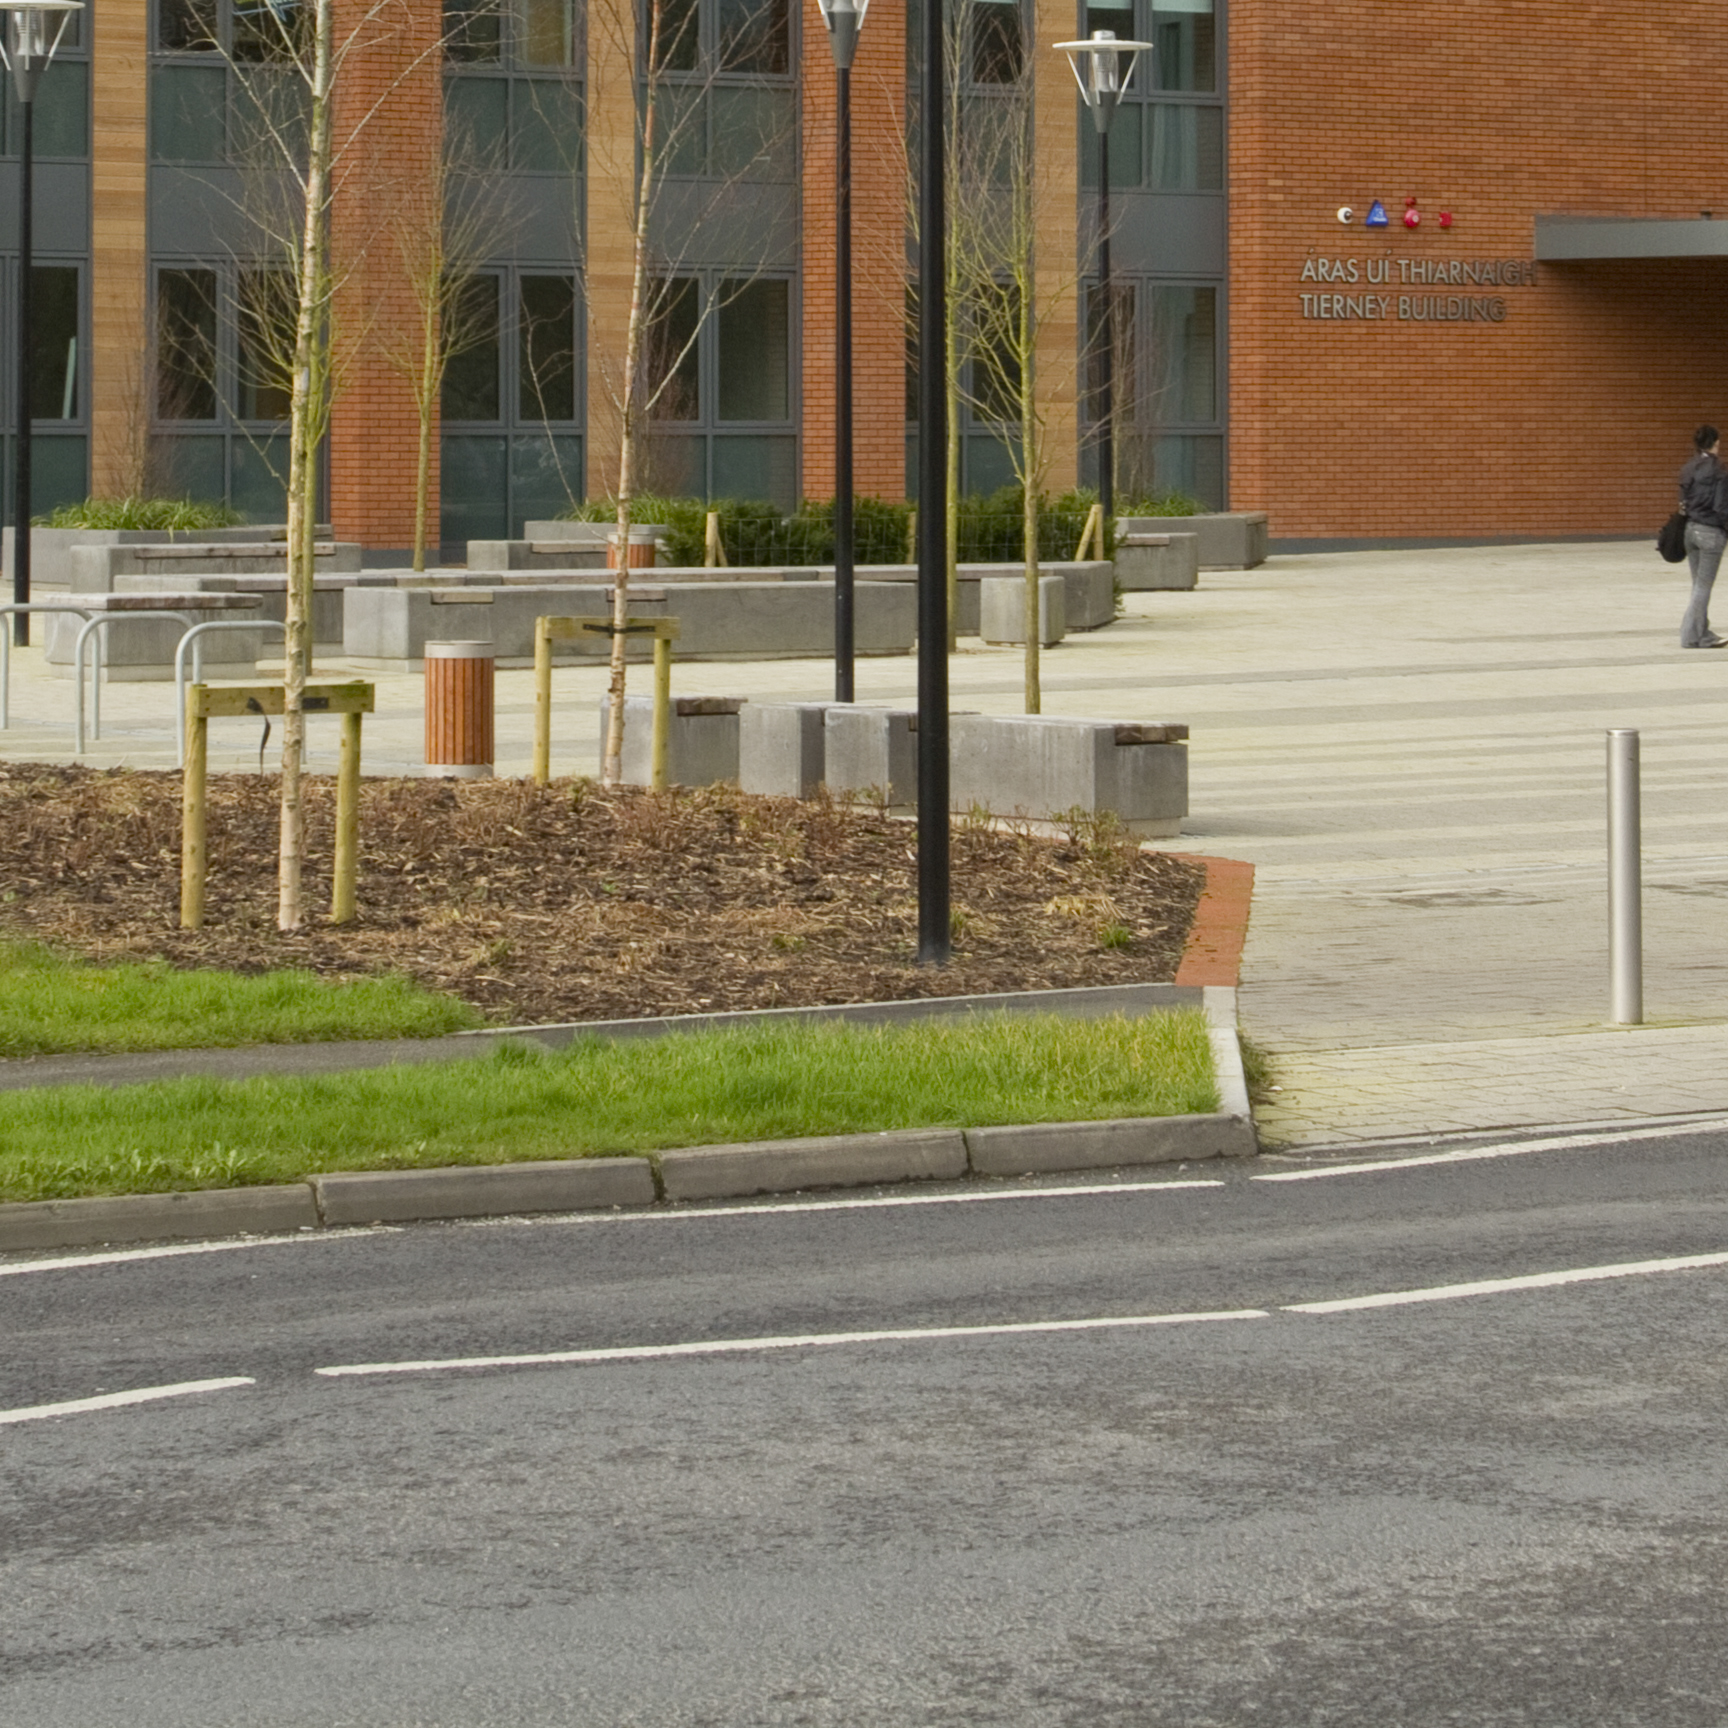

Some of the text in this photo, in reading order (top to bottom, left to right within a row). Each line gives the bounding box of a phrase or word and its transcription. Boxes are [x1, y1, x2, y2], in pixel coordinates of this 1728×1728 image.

[1397, 259, 1538, 286] THIARNAIGH
[1299, 294, 1507, 321] TIERNEY BUILDING
